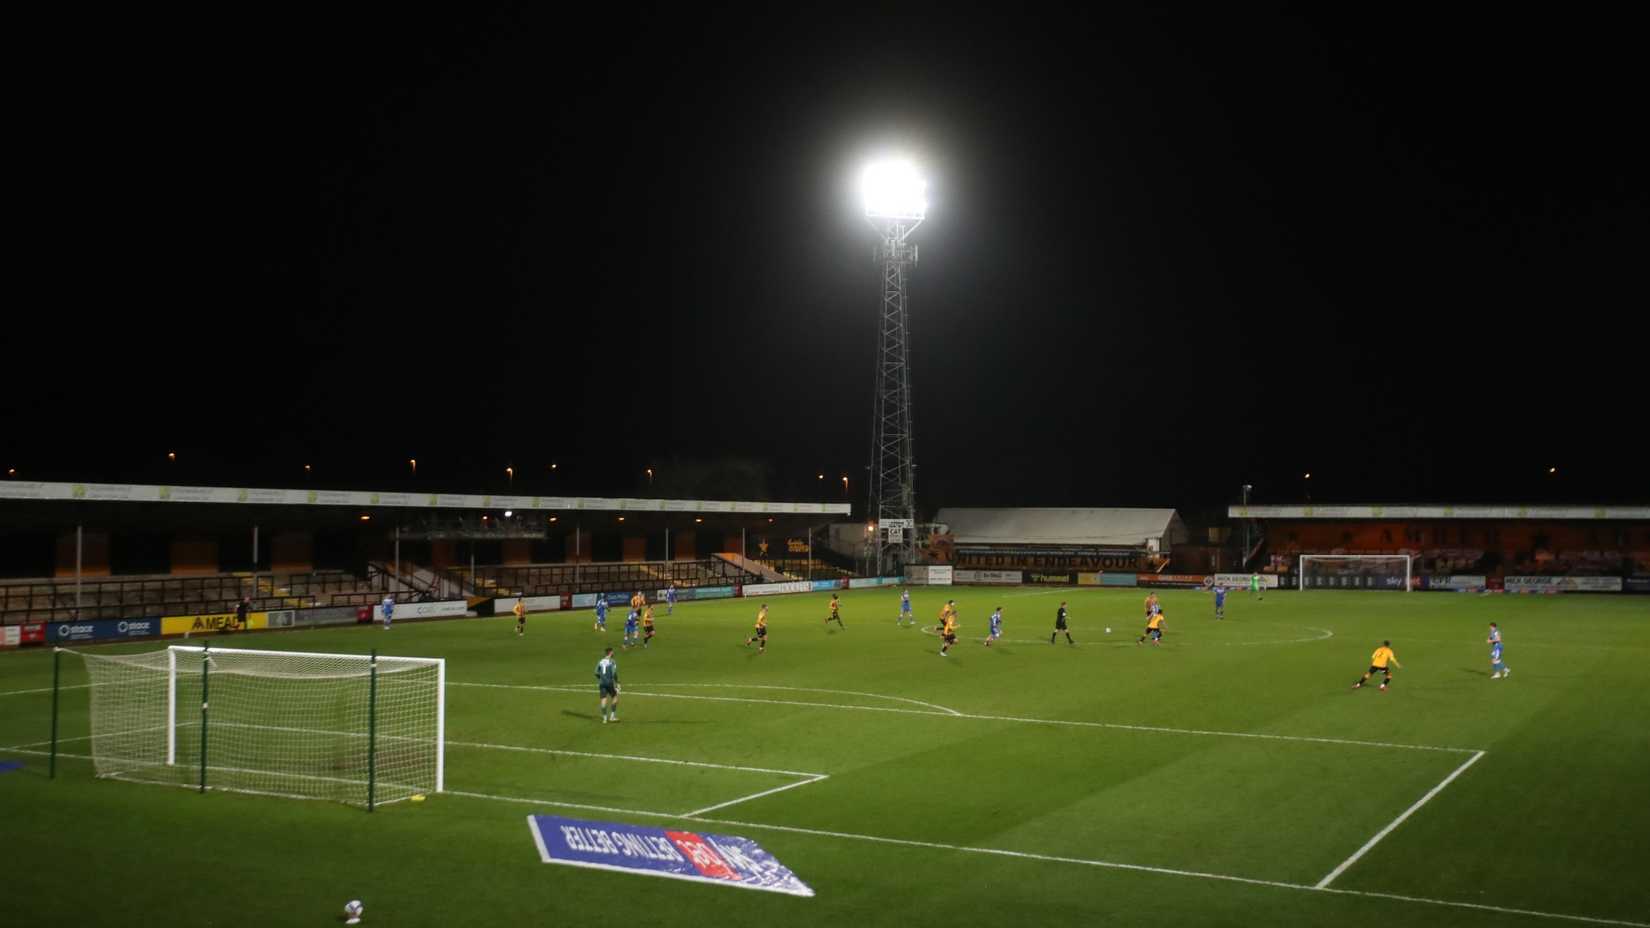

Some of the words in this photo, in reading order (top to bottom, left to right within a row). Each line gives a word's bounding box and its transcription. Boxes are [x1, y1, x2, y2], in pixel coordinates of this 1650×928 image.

[1033, 555, 1137, 569] ENDEAVOUR
[560, 824, 618, 855] BETTER
[614, 831, 684, 862] BETTING
